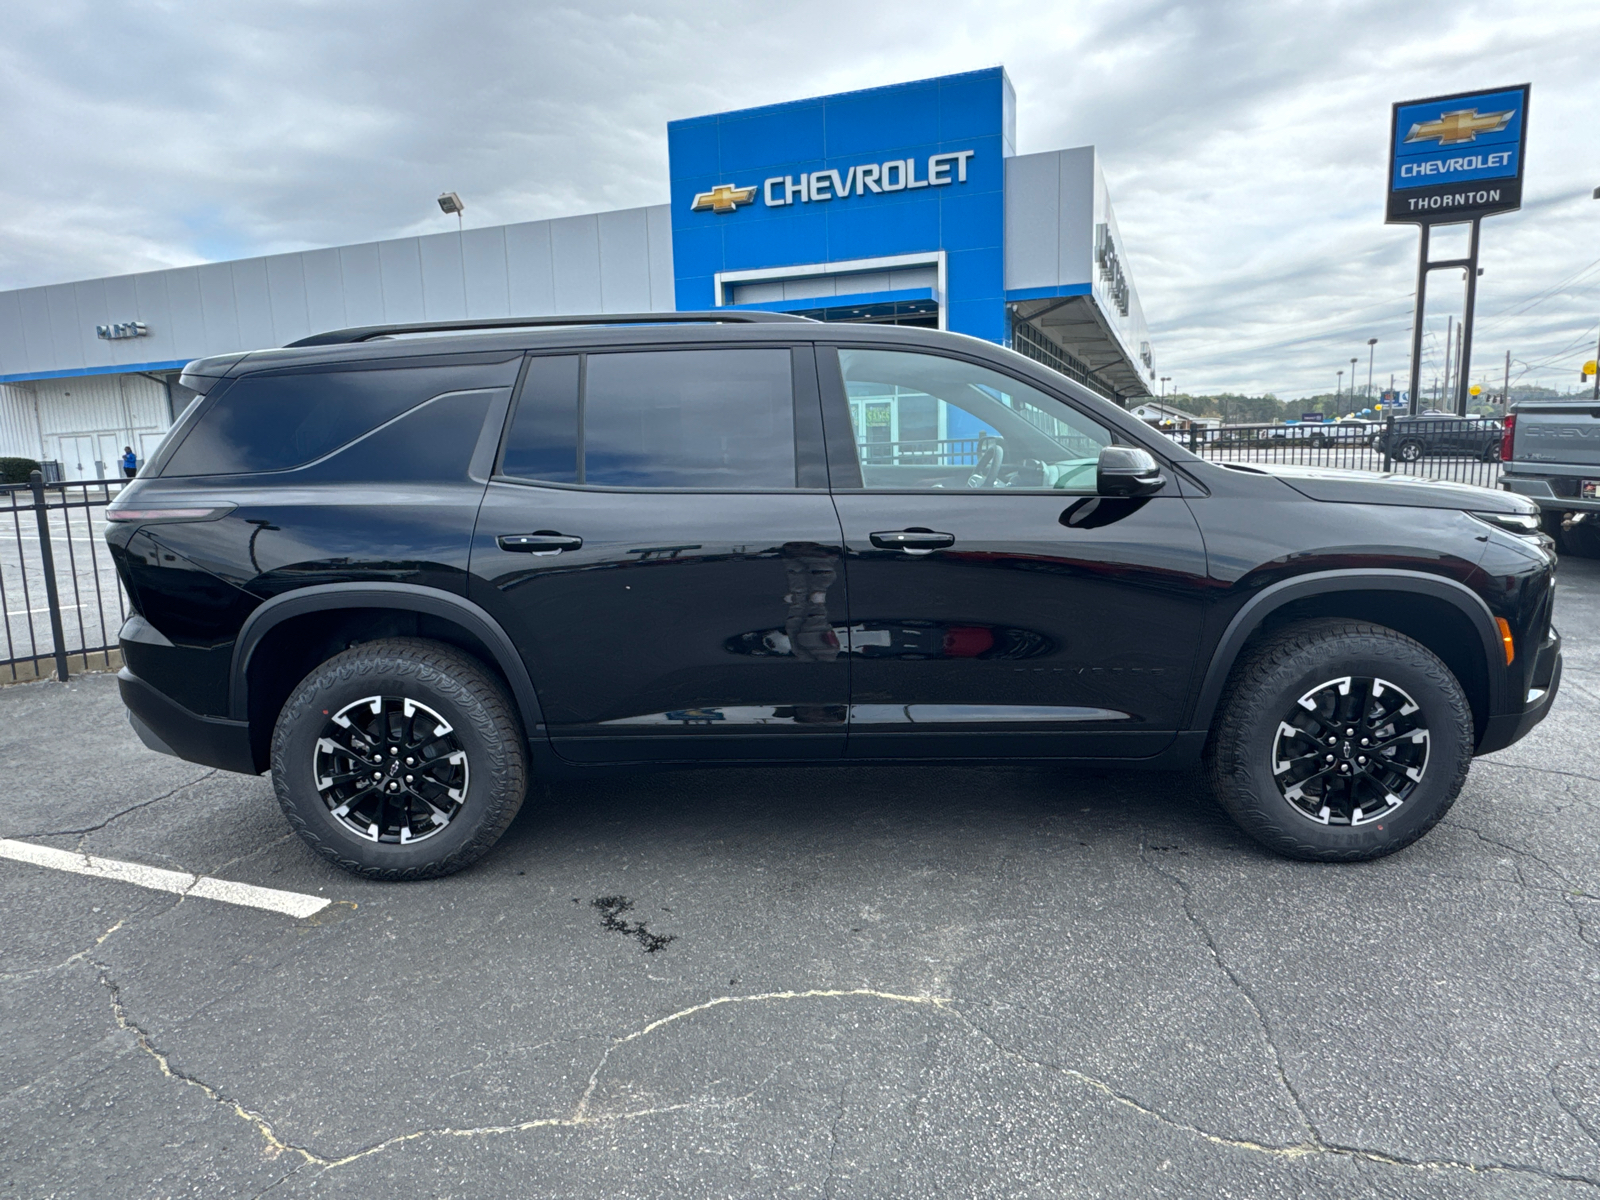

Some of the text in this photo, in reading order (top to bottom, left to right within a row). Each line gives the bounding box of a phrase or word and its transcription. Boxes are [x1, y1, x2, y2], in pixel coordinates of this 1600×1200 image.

[1401, 151, 1513, 178] CHEVROLET
[764, 150, 975, 207] CHEVROLET
[1408, 190, 1501, 211] THORNTON
